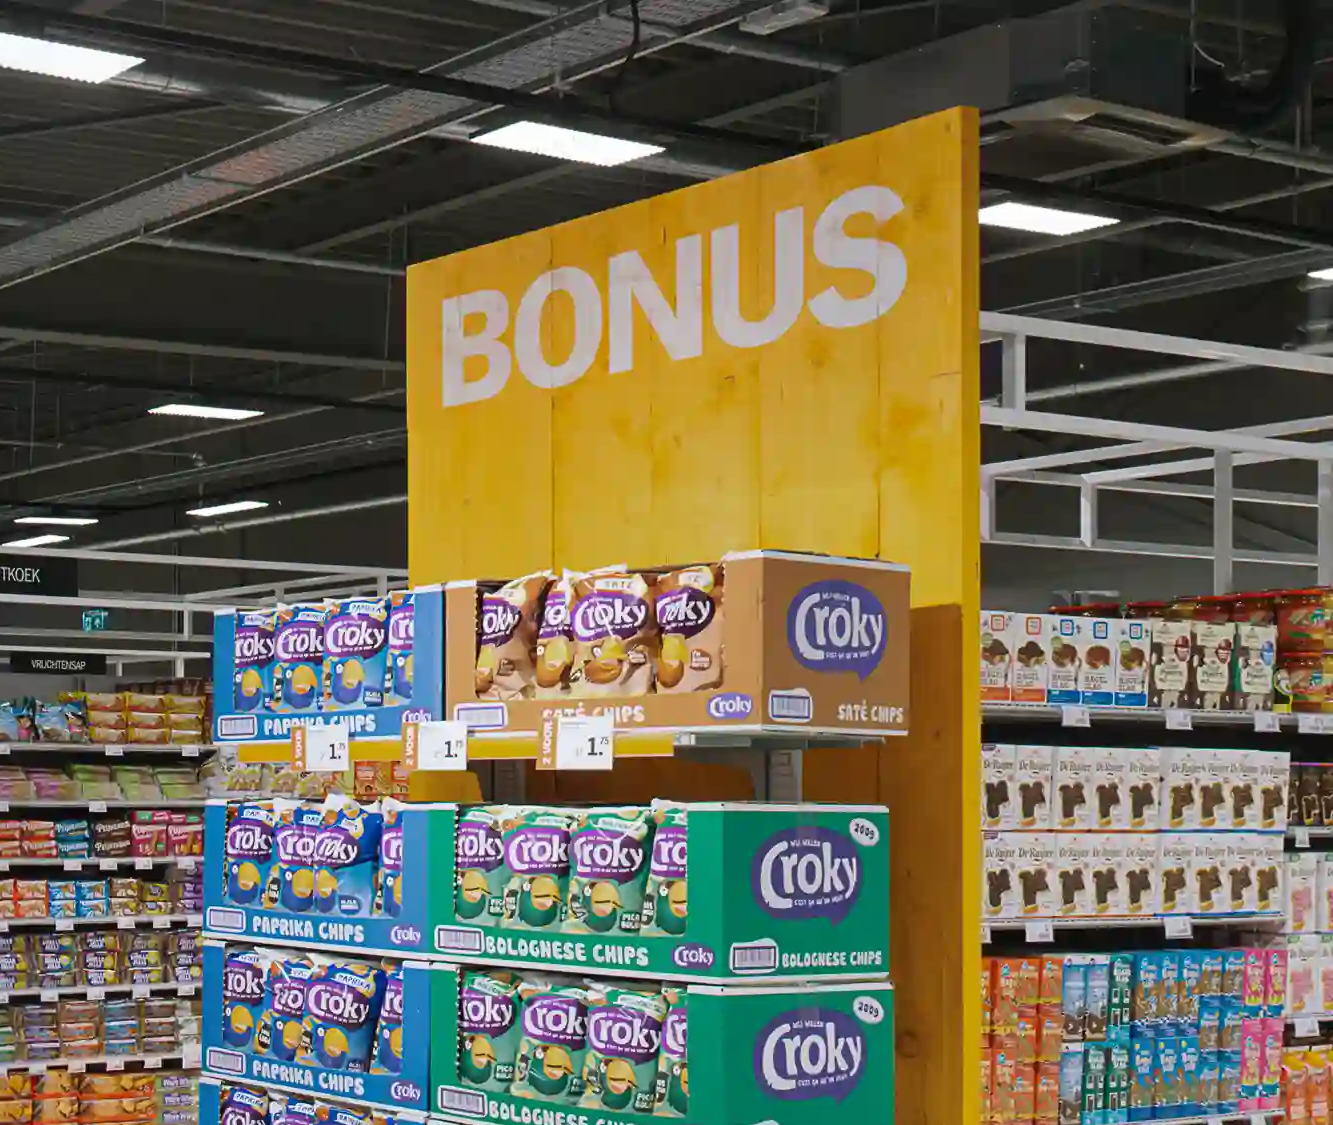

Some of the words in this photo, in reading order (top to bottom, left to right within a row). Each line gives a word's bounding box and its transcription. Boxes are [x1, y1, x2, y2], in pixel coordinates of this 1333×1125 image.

[442, 184, 908, 409] BONUS
[574, 600, 648, 637] Croky
[795, 593, 883, 660] Croky
[235, 630, 275, 661] roky
[276, 628, 324, 659] Crok
[326, 619, 384, 653] Croky
[31, 659, 86, 670] VRUCHTENSAP
[710, 694, 752, 716] Croky
[837, 700, 868, 721] SATÉ
[870, 705, 904, 723] CHIPS
[458, 830, 504, 862] roky
[509, 833, 569, 871] Crok
[574, 835, 643, 873] Croky
[760, 840, 857, 909] Croky
[252, 915, 314, 938] PAPRIKA
[318, 922, 365, 943] CHIPS
[390, 925, 421, 944] Croky
[484, 935, 587, 962] BOLOGNESE
[592, 944, 649, 966] CHIPS
[673, 946, 714, 966] Croky
[782, 951, 847, 968] BOLOGNESE
[850, 950, 882, 966] CHIPS
[308, 984, 370, 1025] Croky
[461, 996, 514, 1028] roky
[524, 998, 588, 1039] Crok
[589, 1011, 661, 1053] Croky
[762, 1022, 861, 1090] Croky
[252, 1059, 314, 1087] PAPRIKA
[318, 1071, 365, 1096] CHIPS
[390, 1081, 421, 1101] Croky
